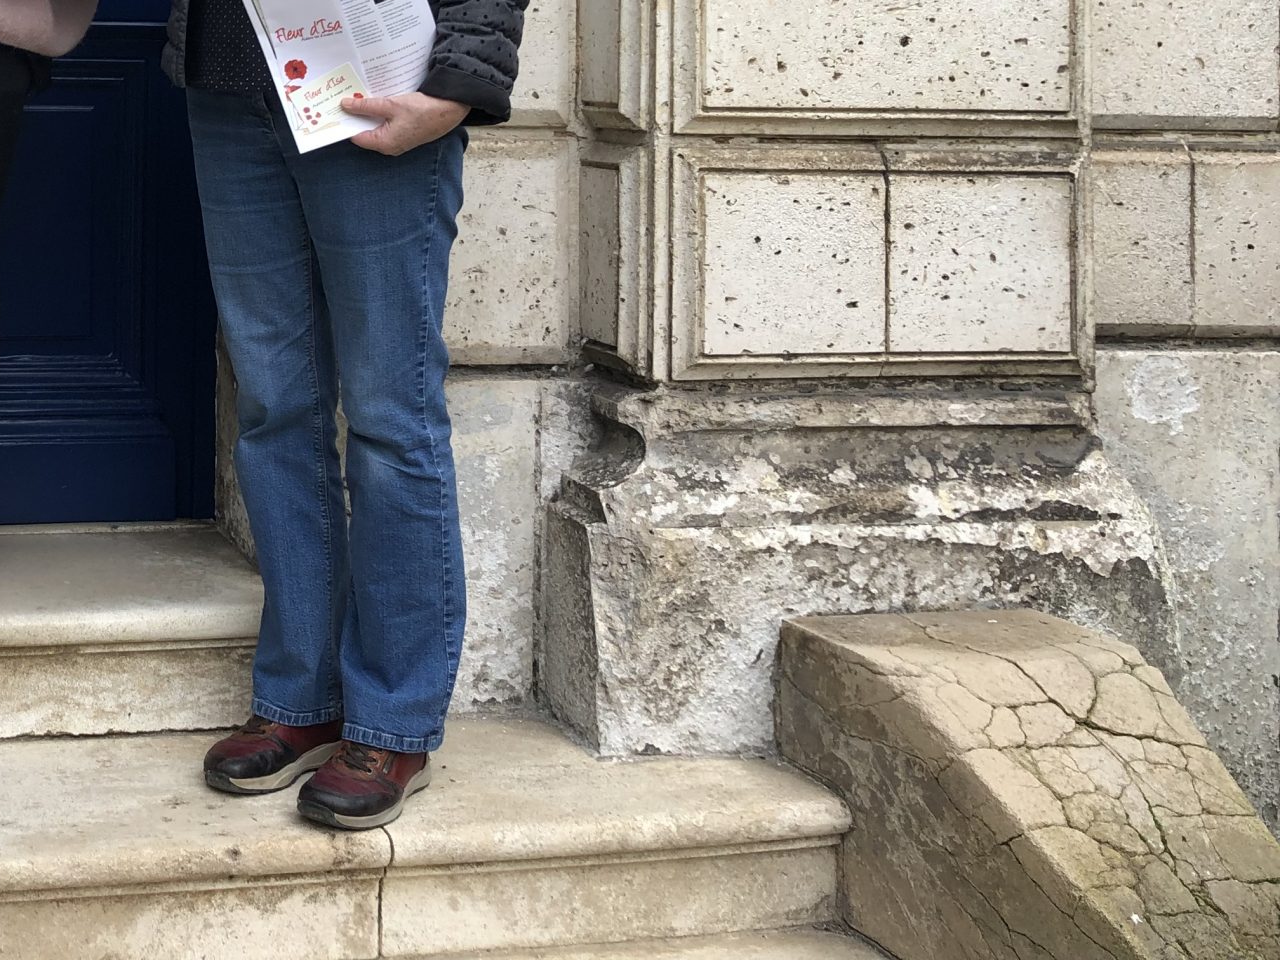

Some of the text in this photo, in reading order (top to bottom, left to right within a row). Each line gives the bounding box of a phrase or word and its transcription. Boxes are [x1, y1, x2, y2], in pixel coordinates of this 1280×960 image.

[274, 27, 305, 43] Fleur
[310, 18, 343, 36] d'Isa
[304, 86, 322, 102] Fleur
[325, 75, 346, 91] d'Isa
